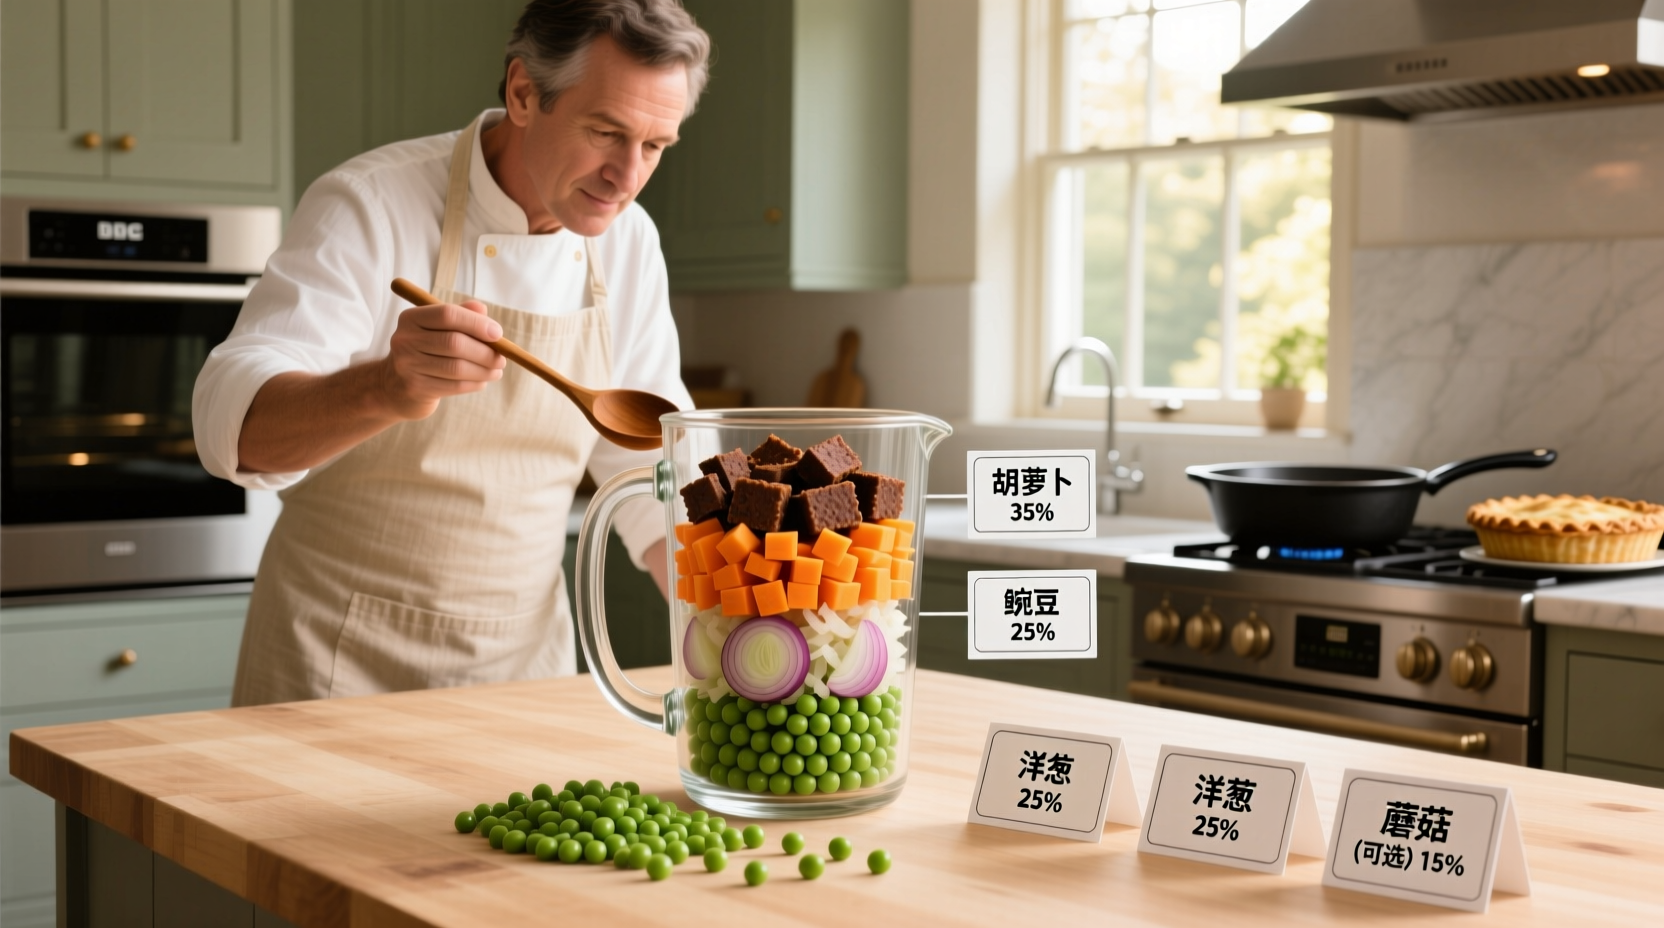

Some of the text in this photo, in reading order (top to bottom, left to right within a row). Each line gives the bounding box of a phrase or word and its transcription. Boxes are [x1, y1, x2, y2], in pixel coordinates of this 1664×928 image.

[992, 466, 1072, 497] 胡萝卜
[1010, 502, 1054, 522] 35%
[1010, 622, 1056, 641] 25%
[1017, 788, 1063, 813] 25%
[1192, 773, 1257, 813] 洋葱
[1191, 815, 1239, 841] 25%
[1379, 801, 1454, 844] 蘑菇
[1421, 850, 1465, 877] 15%
